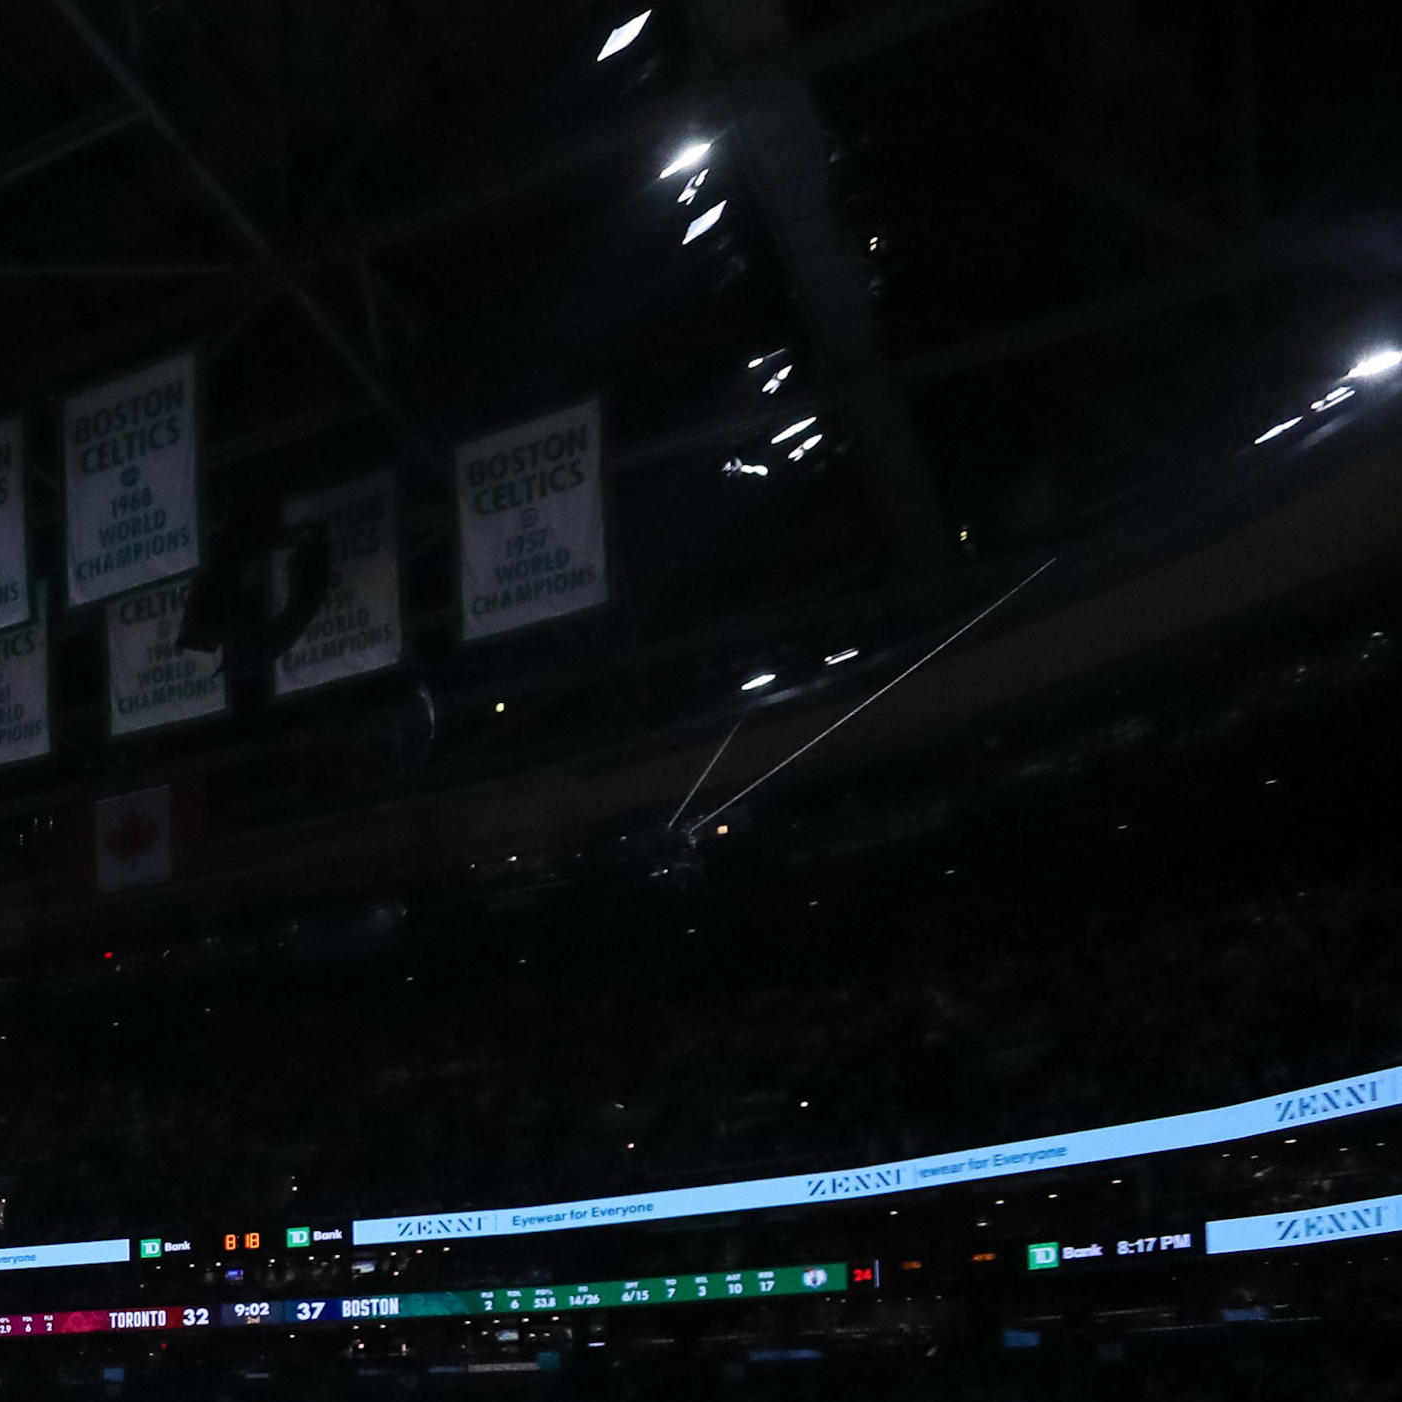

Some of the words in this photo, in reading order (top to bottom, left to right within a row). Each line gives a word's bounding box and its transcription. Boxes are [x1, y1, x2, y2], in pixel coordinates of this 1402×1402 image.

[74, 378, 184, 443] BOSTON
[80, 417, 180, 476] CELTICS
[469, 424, 588, 488] BOSTON
[473, 460, 584, 515] CELTICS
[99, 510, 167, 548] WORLD
[76, 527, 191, 582] CHAMPIONS
[495, 548, 571, 582] WORLD
[471, 566, 596, 617] CHAMPIONS
[118, 675, 217, 715] CHAMPIONS
[1275, 1080, 1378, 1122] ZENNI
[808, 1168, 903, 1196] ZENNI
[968, 1154, 989, 1172] for
[992, 1143, 1068, 1169] Everyone
[289, 1231, 308, 1245] TD
[313, 1228, 343, 1243] Bank
[398, 1217, 486, 1237] ZENNI
[512, 1211, 566, 1229] Eyewear
[569, 1208, 587, 1223] for
[591, 1202, 655, 1221] Everyone
[1276, 1206, 1384, 1241] ZENNI
[143, 1242, 160, 1254] TD
[164, 1240, 191, 1252] Bank
[1033, 1246, 1056, 1264] TD
[1063, 1242, 1104, 1260] Bank
[1116, 1236, 1156, 1256] 8:17
[1159, 1233, 1192, 1251] PM
[108, 1310, 167, 1330] TORONTO
[182, 1308, 209, 1326] 32
[234, 1301, 270, 1317] 9:02
[296, 1302, 325, 1321] 37
[342, 1297, 400, 1318] BOSTON
